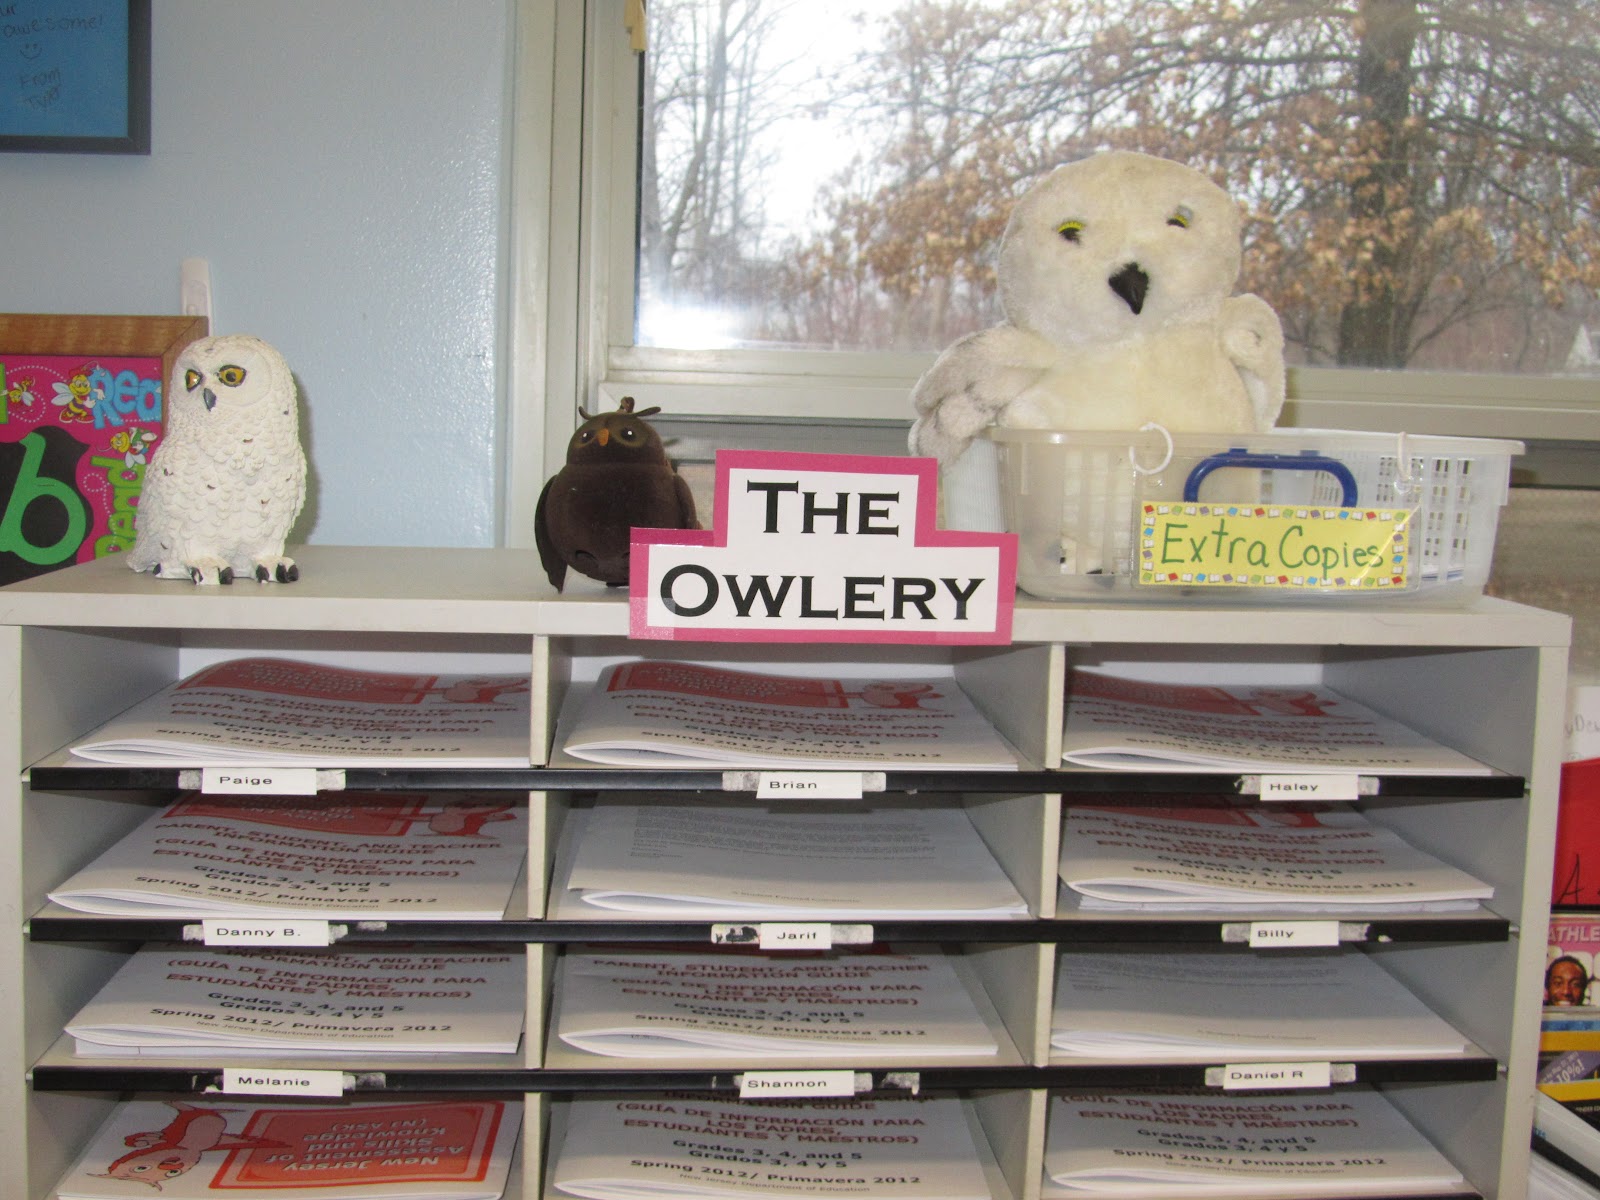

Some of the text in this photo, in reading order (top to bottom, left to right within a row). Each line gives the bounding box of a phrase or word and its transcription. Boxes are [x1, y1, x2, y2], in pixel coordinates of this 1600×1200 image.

[746, 479, 901, 538] THE
[1160, 517, 1384, 581] Extra Copies
[659, 563, 986, 622] OWLERY
[219, 776, 273, 786] Paige
[769, 781, 817, 789] Brian
[1270, 783, 1319, 791] Haley
[213, 831, 360, 854] INFORMATION
[153, 849, 304, 872] ESTUDIANTES
[332, 869, 460, 878] MAESTROS)
[243, 854, 286, 864] LOS
[192, 865, 269, 880] Grades
[134, 876, 201, 889] Spring
[276, 894, 381, 904] Primavera
[216, 928, 301, 938] Danny B.
[777, 932, 817, 940] Jarif
[1257, 930, 1294, 939] Billy
[166, 973, 316, 995] ESTUDIANTES
[345, 990, 473, 999] MAESTROS)
[256, 975, 298, 986] LOS
[207, 992, 283, 1006] Grades
[220, 1001, 296, 1015] Grados
[149, 1008, 216, 1020] Spring
[292, 1022, 395, 1032] Primavera
[238, 1076, 310, 1087] Melanie
[1230, 1070, 1304, 1080] Daniel R
[747, 1080, 828, 1089] Shannon
[332, 1119, 428, 1130] (NJ ASK)
[706, 1120, 746, 1129] LOS
[872, 1118, 926, 1126] PARA
[303, 1127, 446, 1141] Knowledge
[624, 1119, 769, 1140] ESTUDIANTES
[797, 1135, 919, 1144] MAESTROS)
[308, 1137, 433, 1151] Skills and
[672, 1139, 745, 1154] Grades
[805, 1152, 843, 1160] and
[304, 1146, 465, 1160] Assessment
[689, 1150, 762, 1164] Grados
[283, 1157, 439, 1171] New Jersey
[630, 1159, 694, 1172] Spring
[767, 1174, 867, 1184] Primavera
[872, 1176, 921, 1184] 2012
